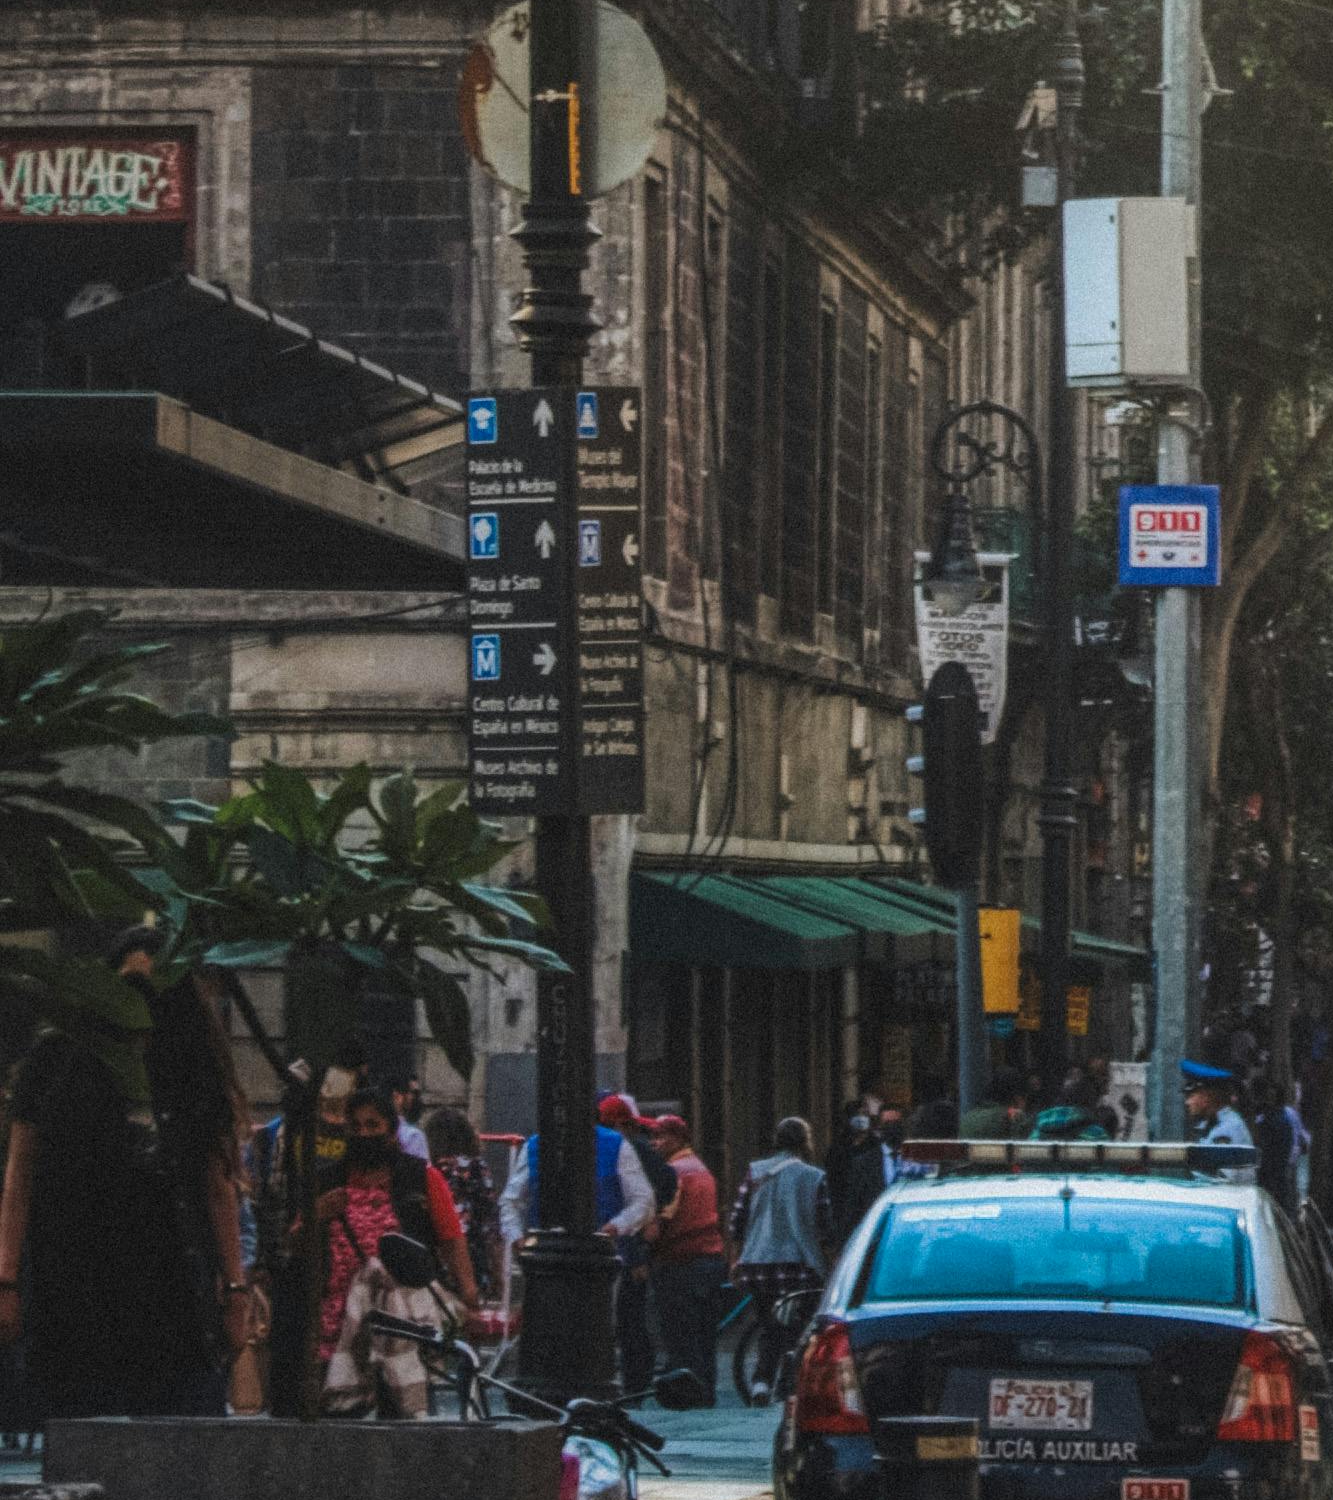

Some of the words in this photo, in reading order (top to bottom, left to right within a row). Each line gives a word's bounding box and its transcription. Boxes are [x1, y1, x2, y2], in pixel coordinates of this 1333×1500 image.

[1140, 512, 1197, 531] 911
[929, 630, 985, 644] FOTOS
[1043, 1440, 1138, 1461] AUXILIAR
[1129, 1484, 1181, 1499] 911
